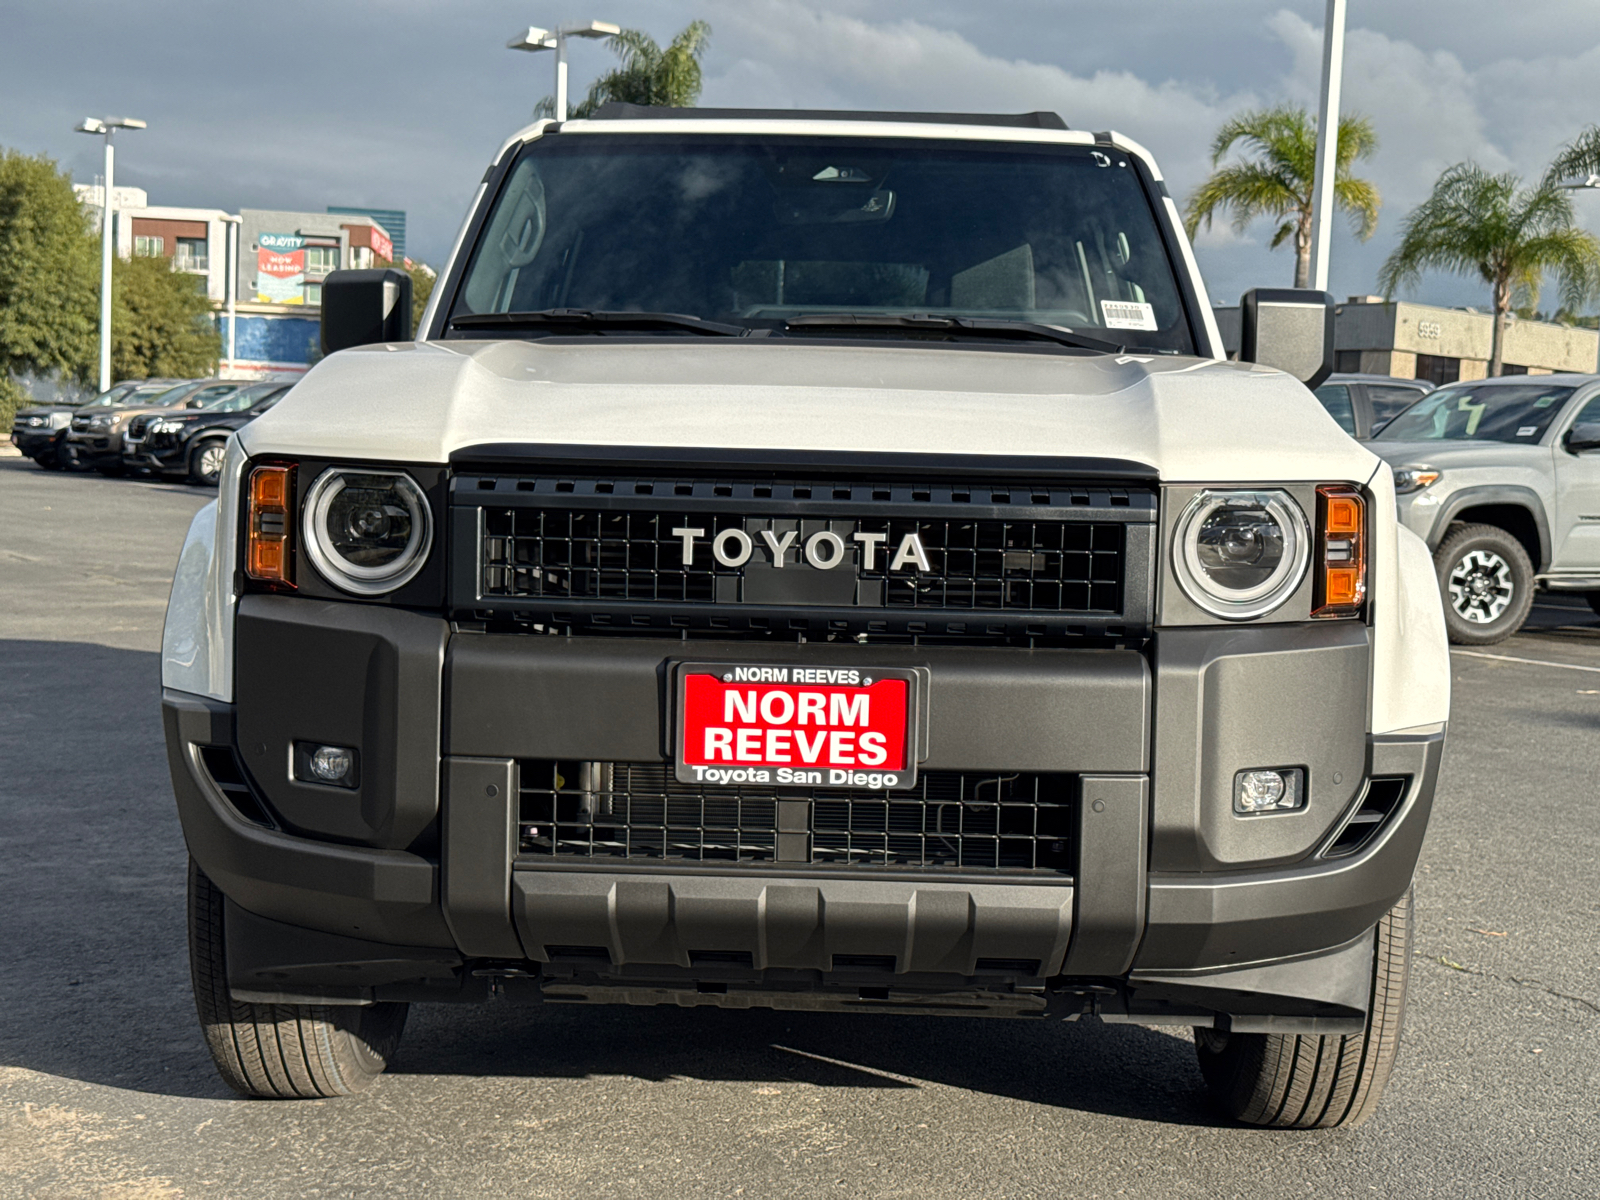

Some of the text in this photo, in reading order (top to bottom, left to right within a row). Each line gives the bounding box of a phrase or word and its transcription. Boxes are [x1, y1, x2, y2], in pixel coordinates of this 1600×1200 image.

[261, 235, 303, 248] GRAVITY
[261, 263, 302, 273] LEASING
[269, 256, 293, 264] NOW
[672, 528, 930, 572] TOYOTA
[735, 667, 860, 685] NORM REEVES
[724, 689, 870, 727] NORM
[704, 727, 888, 766] REEVES
[692, 765, 898, 789] Toyota San Diego
